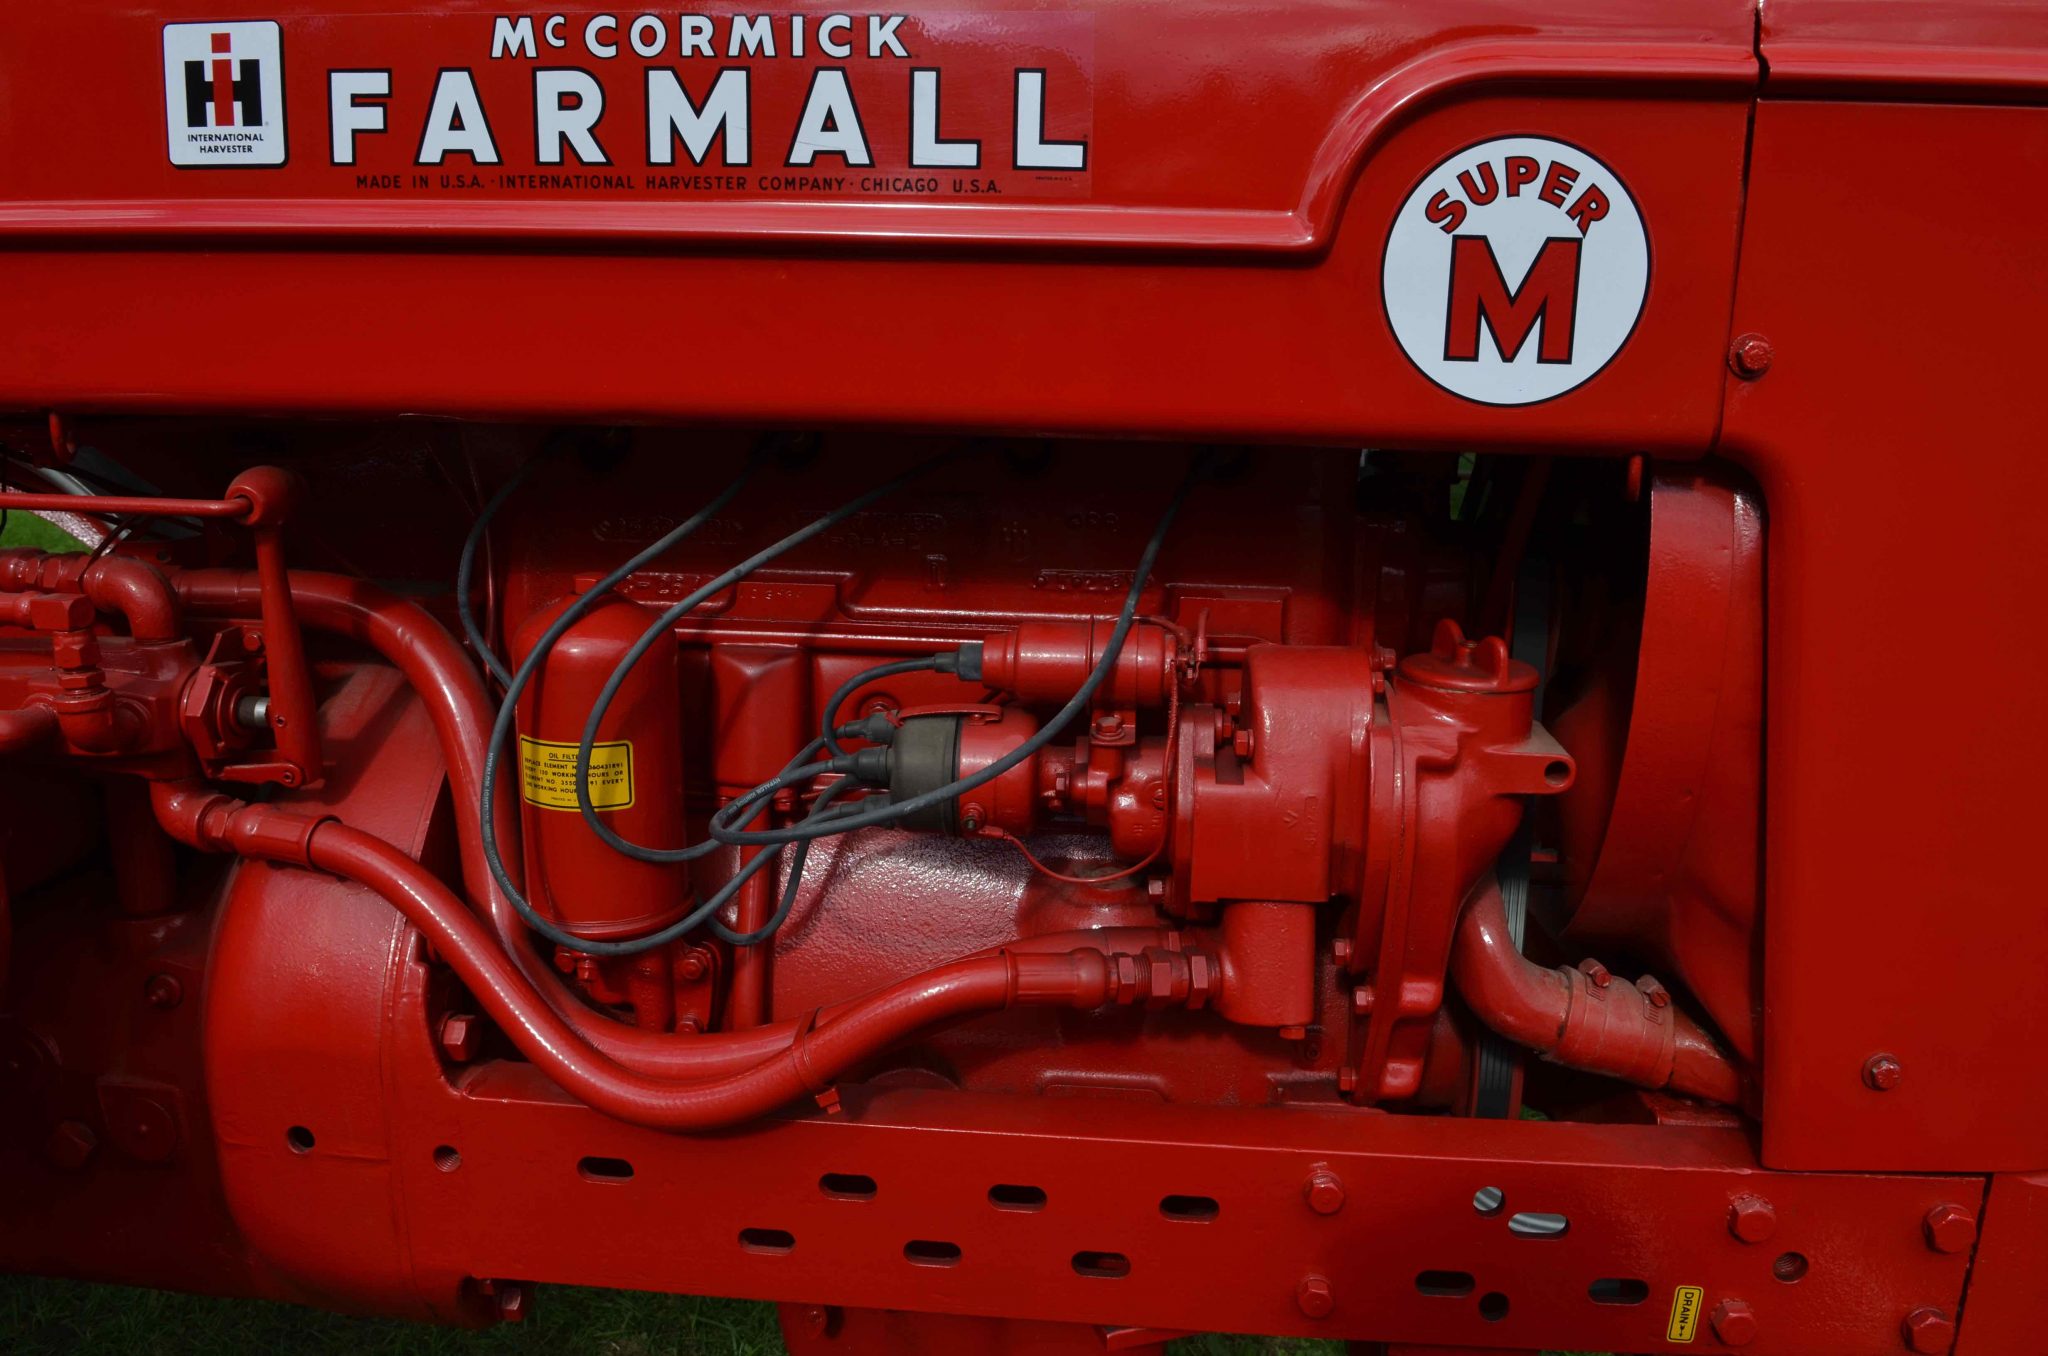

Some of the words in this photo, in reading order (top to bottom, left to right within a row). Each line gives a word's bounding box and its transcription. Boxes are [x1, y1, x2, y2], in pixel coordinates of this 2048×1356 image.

[327, 66, 1088, 171] FARMALL
[188, 133, 264, 143] INTERNATIONAL
[199, 145, 253, 154] HARVESTER
[356, 174, 401, 189] MADE
[413, 174, 429, 189] IN
[441, 175, 485, 189] U.S.A.
[500, 174, 635, 190] INTERNATIONAL
[646, 175, 747, 191] HARVESTER
[758, 176, 845, 192] COMPANY
[861, 177, 939, 193] CHICAGO
[953, 179, 1003, 194] U.S.A.
[1425, 156, 1610, 238] SUPER
[1443, 234, 1583, 365] M
[544, 762, 568, 770] ELEMENT
[548, 752, 559, 760] OIL
[1679, 1292, 1694, 1324] DRAIN
